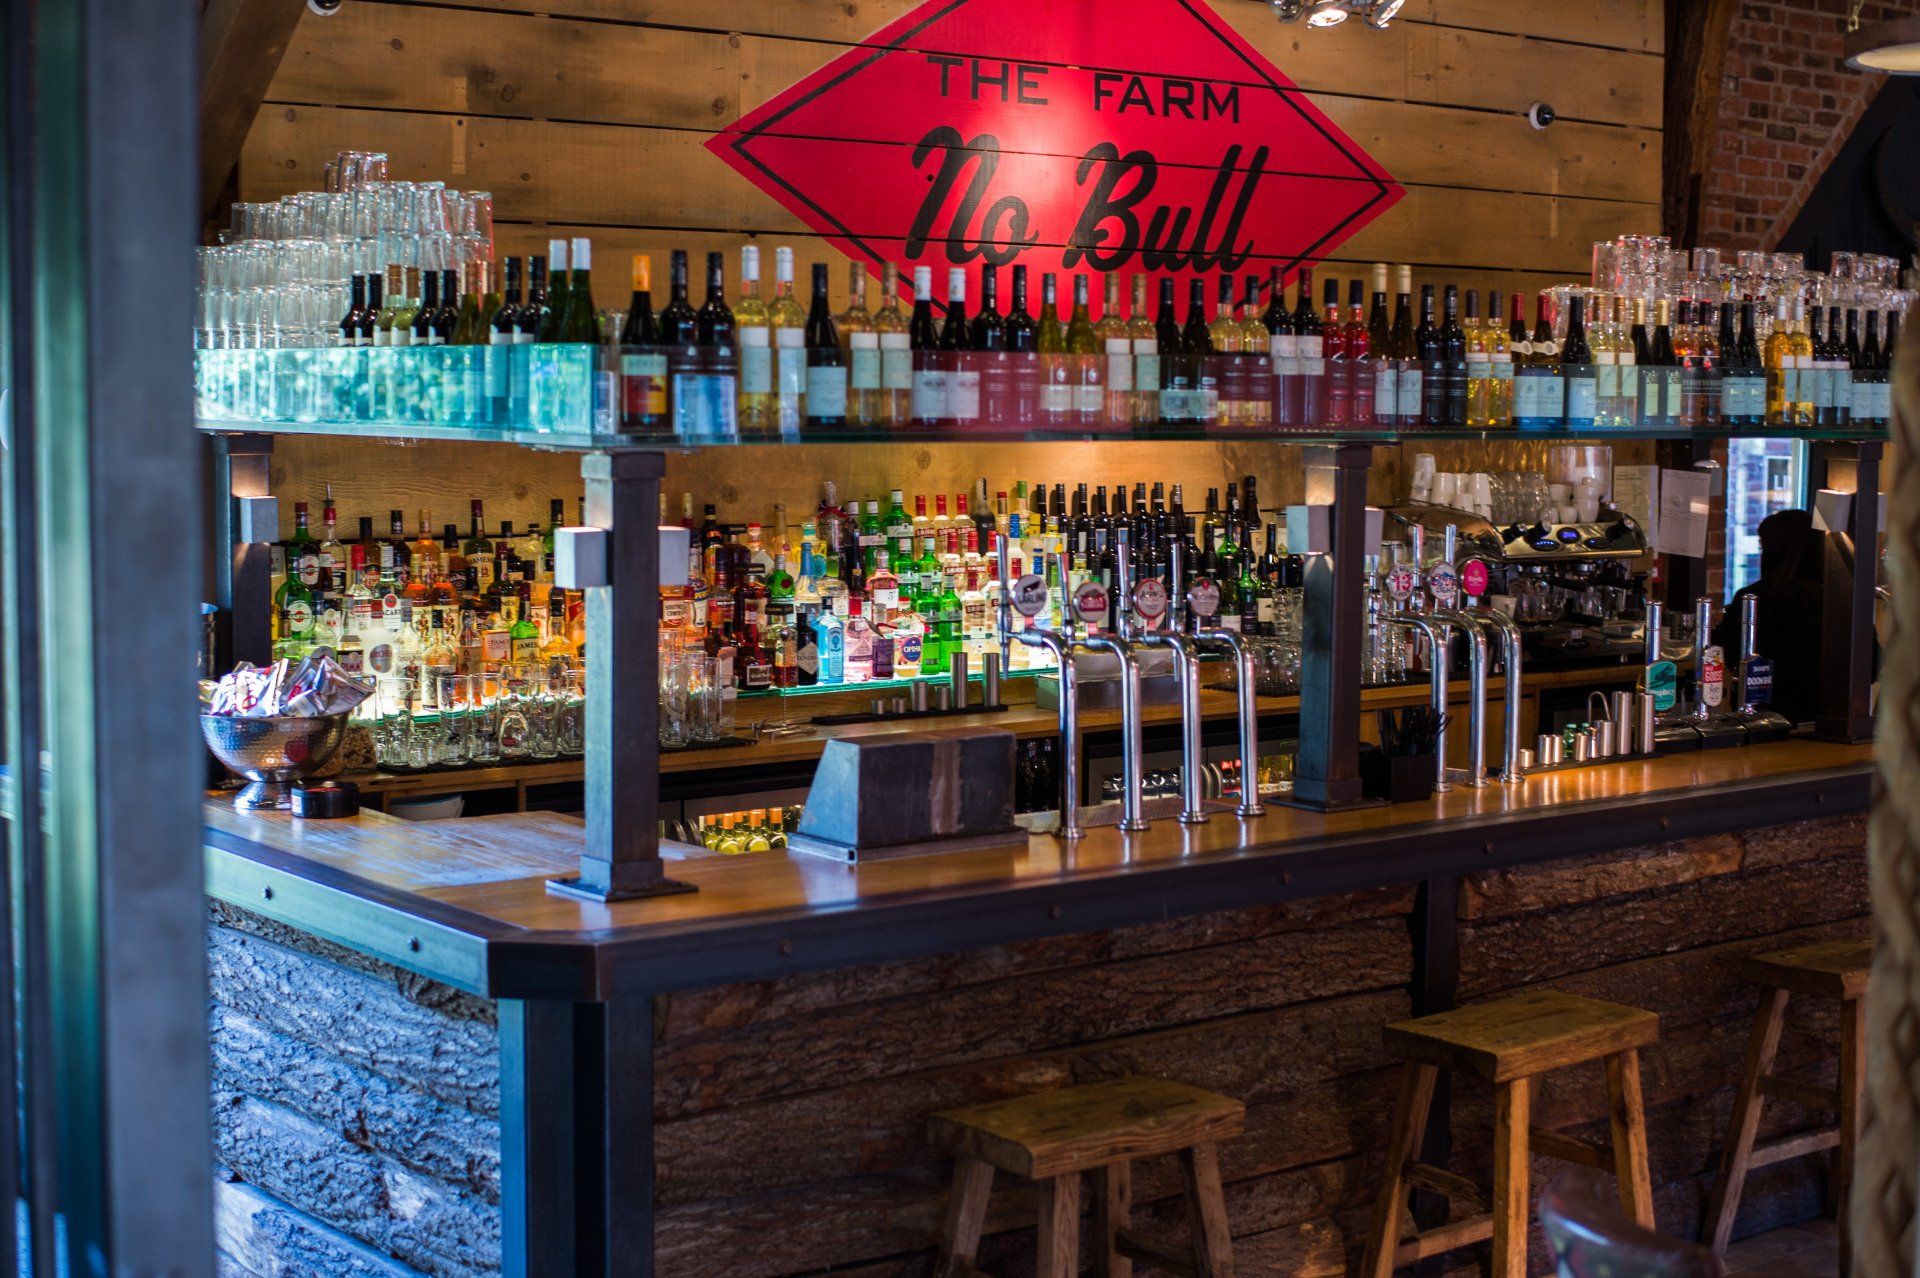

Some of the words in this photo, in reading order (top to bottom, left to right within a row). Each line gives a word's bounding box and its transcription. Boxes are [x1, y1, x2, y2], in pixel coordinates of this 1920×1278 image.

[926, 55, 1048, 106] THE
[1093, 72, 1240, 124] FARM
[905, 125, 1040, 267] No
[1061, 141, 1270, 274] Bull
